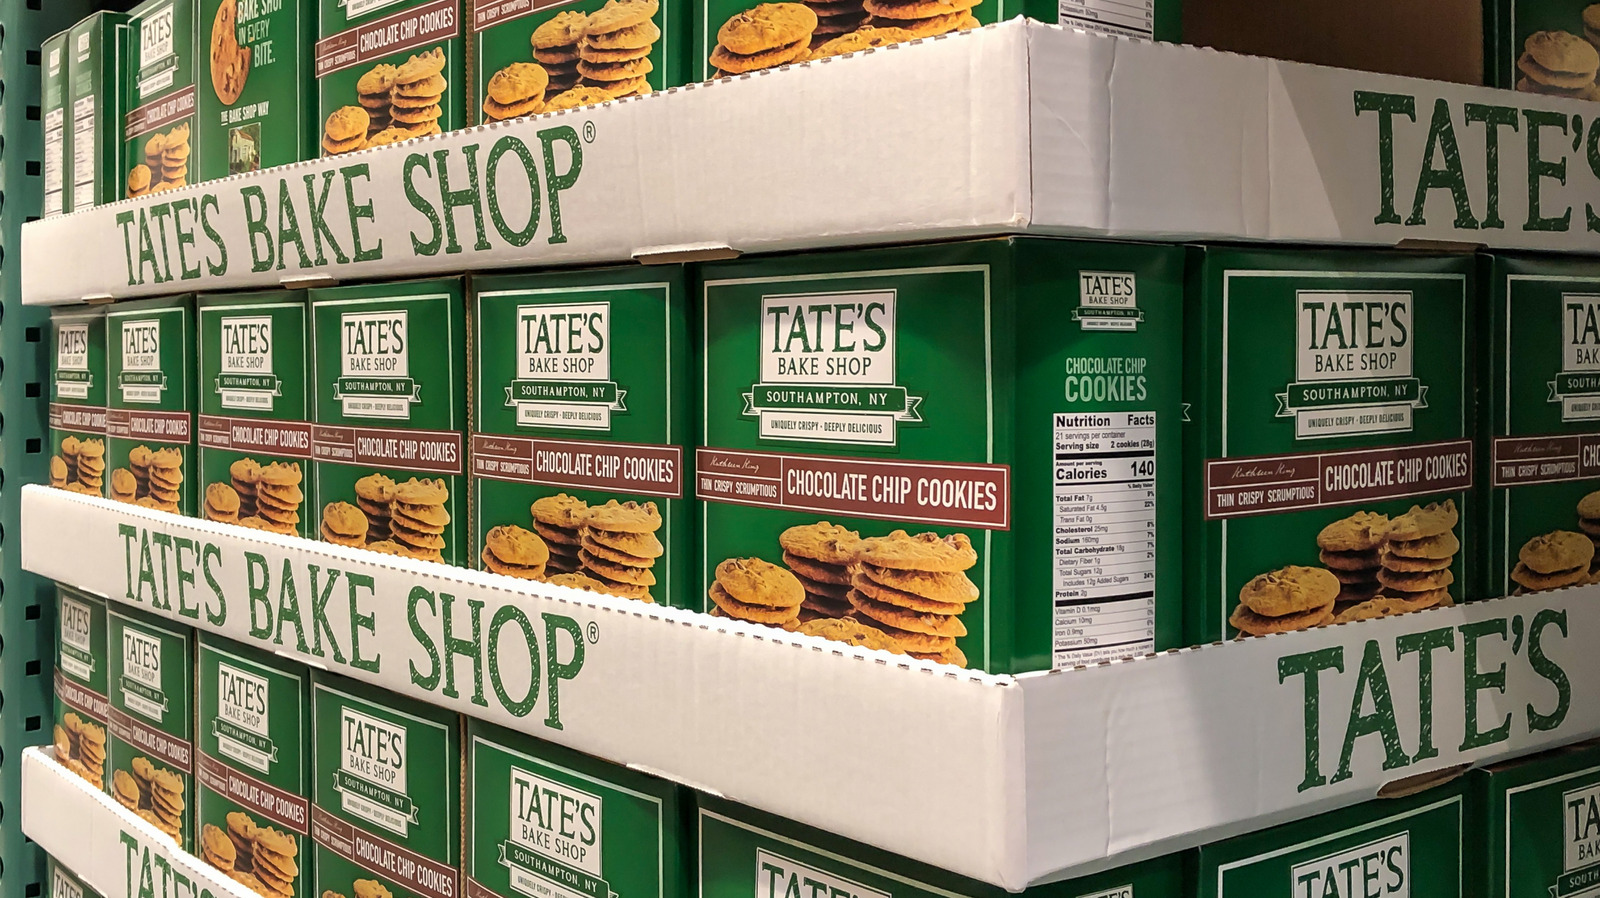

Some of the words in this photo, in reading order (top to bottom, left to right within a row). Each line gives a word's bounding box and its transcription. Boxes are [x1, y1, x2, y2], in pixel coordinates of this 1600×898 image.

[237, 0, 259, 24] BAKE
[142, 12, 171, 50] TATE'S
[238, 26, 246, 45] IN
[248, 18, 271, 43] EVERY
[360, 23, 399, 53] CHOCOLATE
[400, 17, 418, 41] CHIP
[419, 6, 454, 35] COOKIES
[254, 40, 276, 68] BITE.
[229, 107, 241, 123] BAKE
[242, 104, 257, 120] SHOP
[257, 101, 270, 116] WAY
[115, 193, 228, 286] TATE'S
[240, 163, 383, 273] BAKE
[1082, 275, 1133, 296] TATE'S
[344, 319, 404, 355] TATE'S
[521, 312, 604, 354] TATE'S
[767, 302, 887, 353] TATE'S
[1302, 301, 1408, 351] TATE'S
[60, 330, 86, 354] TATE'S
[124, 327, 158, 354] TATE'S
[223, 324, 269, 354] TATE'S
[127, 355, 139, 366] BAKE
[140, 355, 154, 366] SHOP
[227, 356, 244, 368] BAKE
[246, 356, 264, 369] SHOP
[350, 357, 372, 371] BAKE
[374, 357, 397, 371] SHOP
[529, 357, 559, 373] BAKE
[563, 357, 594, 373] SHOP
[777, 357, 819, 376] BAKE
[826, 357, 872, 376] SHOP
[1066, 357, 1123, 374] CHOCOLATE
[1125, 357, 1147, 374] CHIP
[1314, 354, 1354, 373] BAKE
[1360, 352, 1397, 370] SHOP
[396, 383, 405, 391] NY
[521, 385, 589, 398] SOUTHAMPTON,
[592, 387, 605, 398] NY
[766, 391, 862, 406] SOUTHAMPTON,
[869, 393, 888, 405] NY
[1065, 375, 1147, 402] COOKIES
[1303, 387, 1391, 401] SOUTHAMPTON,
[1394, 384, 1408, 396] NY
[131, 417, 154, 433] CHOCOLATE
[155, 419, 165, 434] CHIP
[166, 419, 188, 436] COOKIES
[544, 410, 559, 419] CRISPY
[562, 411, 577, 420] DEEPLY
[579, 412, 602, 421] DELICIOUS
[771, 419, 797, 430] UNIQUELY
[798, 421, 819, 431] CRISPY
[824, 422, 846, 433] DEEPLY
[847, 423, 883, 434] DELICIOUS
[1056, 415, 1111, 427] Nutrition
[1127, 414, 1155, 426] Facts
[1308, 417, 1334, 428] UNIQUELY
[1335, 415, 1355, 426] CRISPY
[1359, 414, 1378, 425] DEEPLY
[1379, 412, 1404, 423] DELICIOUS
[232, 426, 264, 445] CHOCOLATE
[264, 428, 279, 446] CHIP
[280, 430, 309, 449] COOKIES
[357, 436, 398, 458] CHOCOLATE
[399, 439, 417, 460] CHIP
[420, 441, 457, 463] COOKIES
[1056, 442, 1083, 451] Serving
[536, 450, 592, 476] CHOCOLATE
[595, 454, 621, 478] CHIP
[623, 456, 674, 483] COOKIES
[1056, 468, 1107, 480] Calories
[1131, 460, 1155, 477] 140
[1325, 460, 1394, 492] CHOCOLATE
[1397, 454, 1423, 484] CHIP
[1425, 452, 1468, 481] COOKIES
[1501, 465, 1515, 478] THIN
[1518, 463, 1539, 477] CRISPY
[700, 477, 713, 491] THIN
[714, 479, 734, 493] CRISPY
[735, 482, 777, 498] SCRUMPTIOUS
[787, 468, 867, 502] CHOCOLATE
[872, 474, 912, 505] CHIP
[917, 479, 997, 511] COOKIES
[1217, 493, 1235, 508] THIN
[1238, 490, 1264, 505] CRISPY
[1267, 486, 1315, 503] SCRUMPTIOUS
[1074, 545, 1114, 553] Carbohydrate
[118, 523, 227, 627] TATE'S
[244, 551, 381, 674] BAKE
[63, 602, 89, 636] TATE'S
[125, 634, 159, 671] TATE'S
[128, 663, 140, 678] BAKE
[141, 668, 155, 683] SHOP
[221, 670, 265, 716] TATE'S
[1277, 608, 1572, 793] TATE'S
[224, 703, 241, 721] BAKE
[242, 711, 260, 729] SHOP
[133, 725, 156, 749] CHOCOLATE
[156, 737, 167, 754] CHIP
[167, 741, 189, 765] COOKIES
[344, 716, 403, 770] TATE'S
[349, 754, 371, 775] BAKE
[373, 764, 396, 784] SHOP
[228, 775, 260, 806] CHOCOLATE
[260, 789, 275, 812] CHIP
[275, 796, 304, 825] COOKIES
[394, 794, 404, 808] NY
[514, 777, 596, 847] TATE'S
[522, 824, 550, 850] BAKE
[554, 838, 587, 863] SHOP
[356, 836, 396, 872] CHOCOLATE
[397, 855, 415, 881] CHIP
[417, 864, 452, 897] COOKIES
[584, 880, 597, 893] NY
